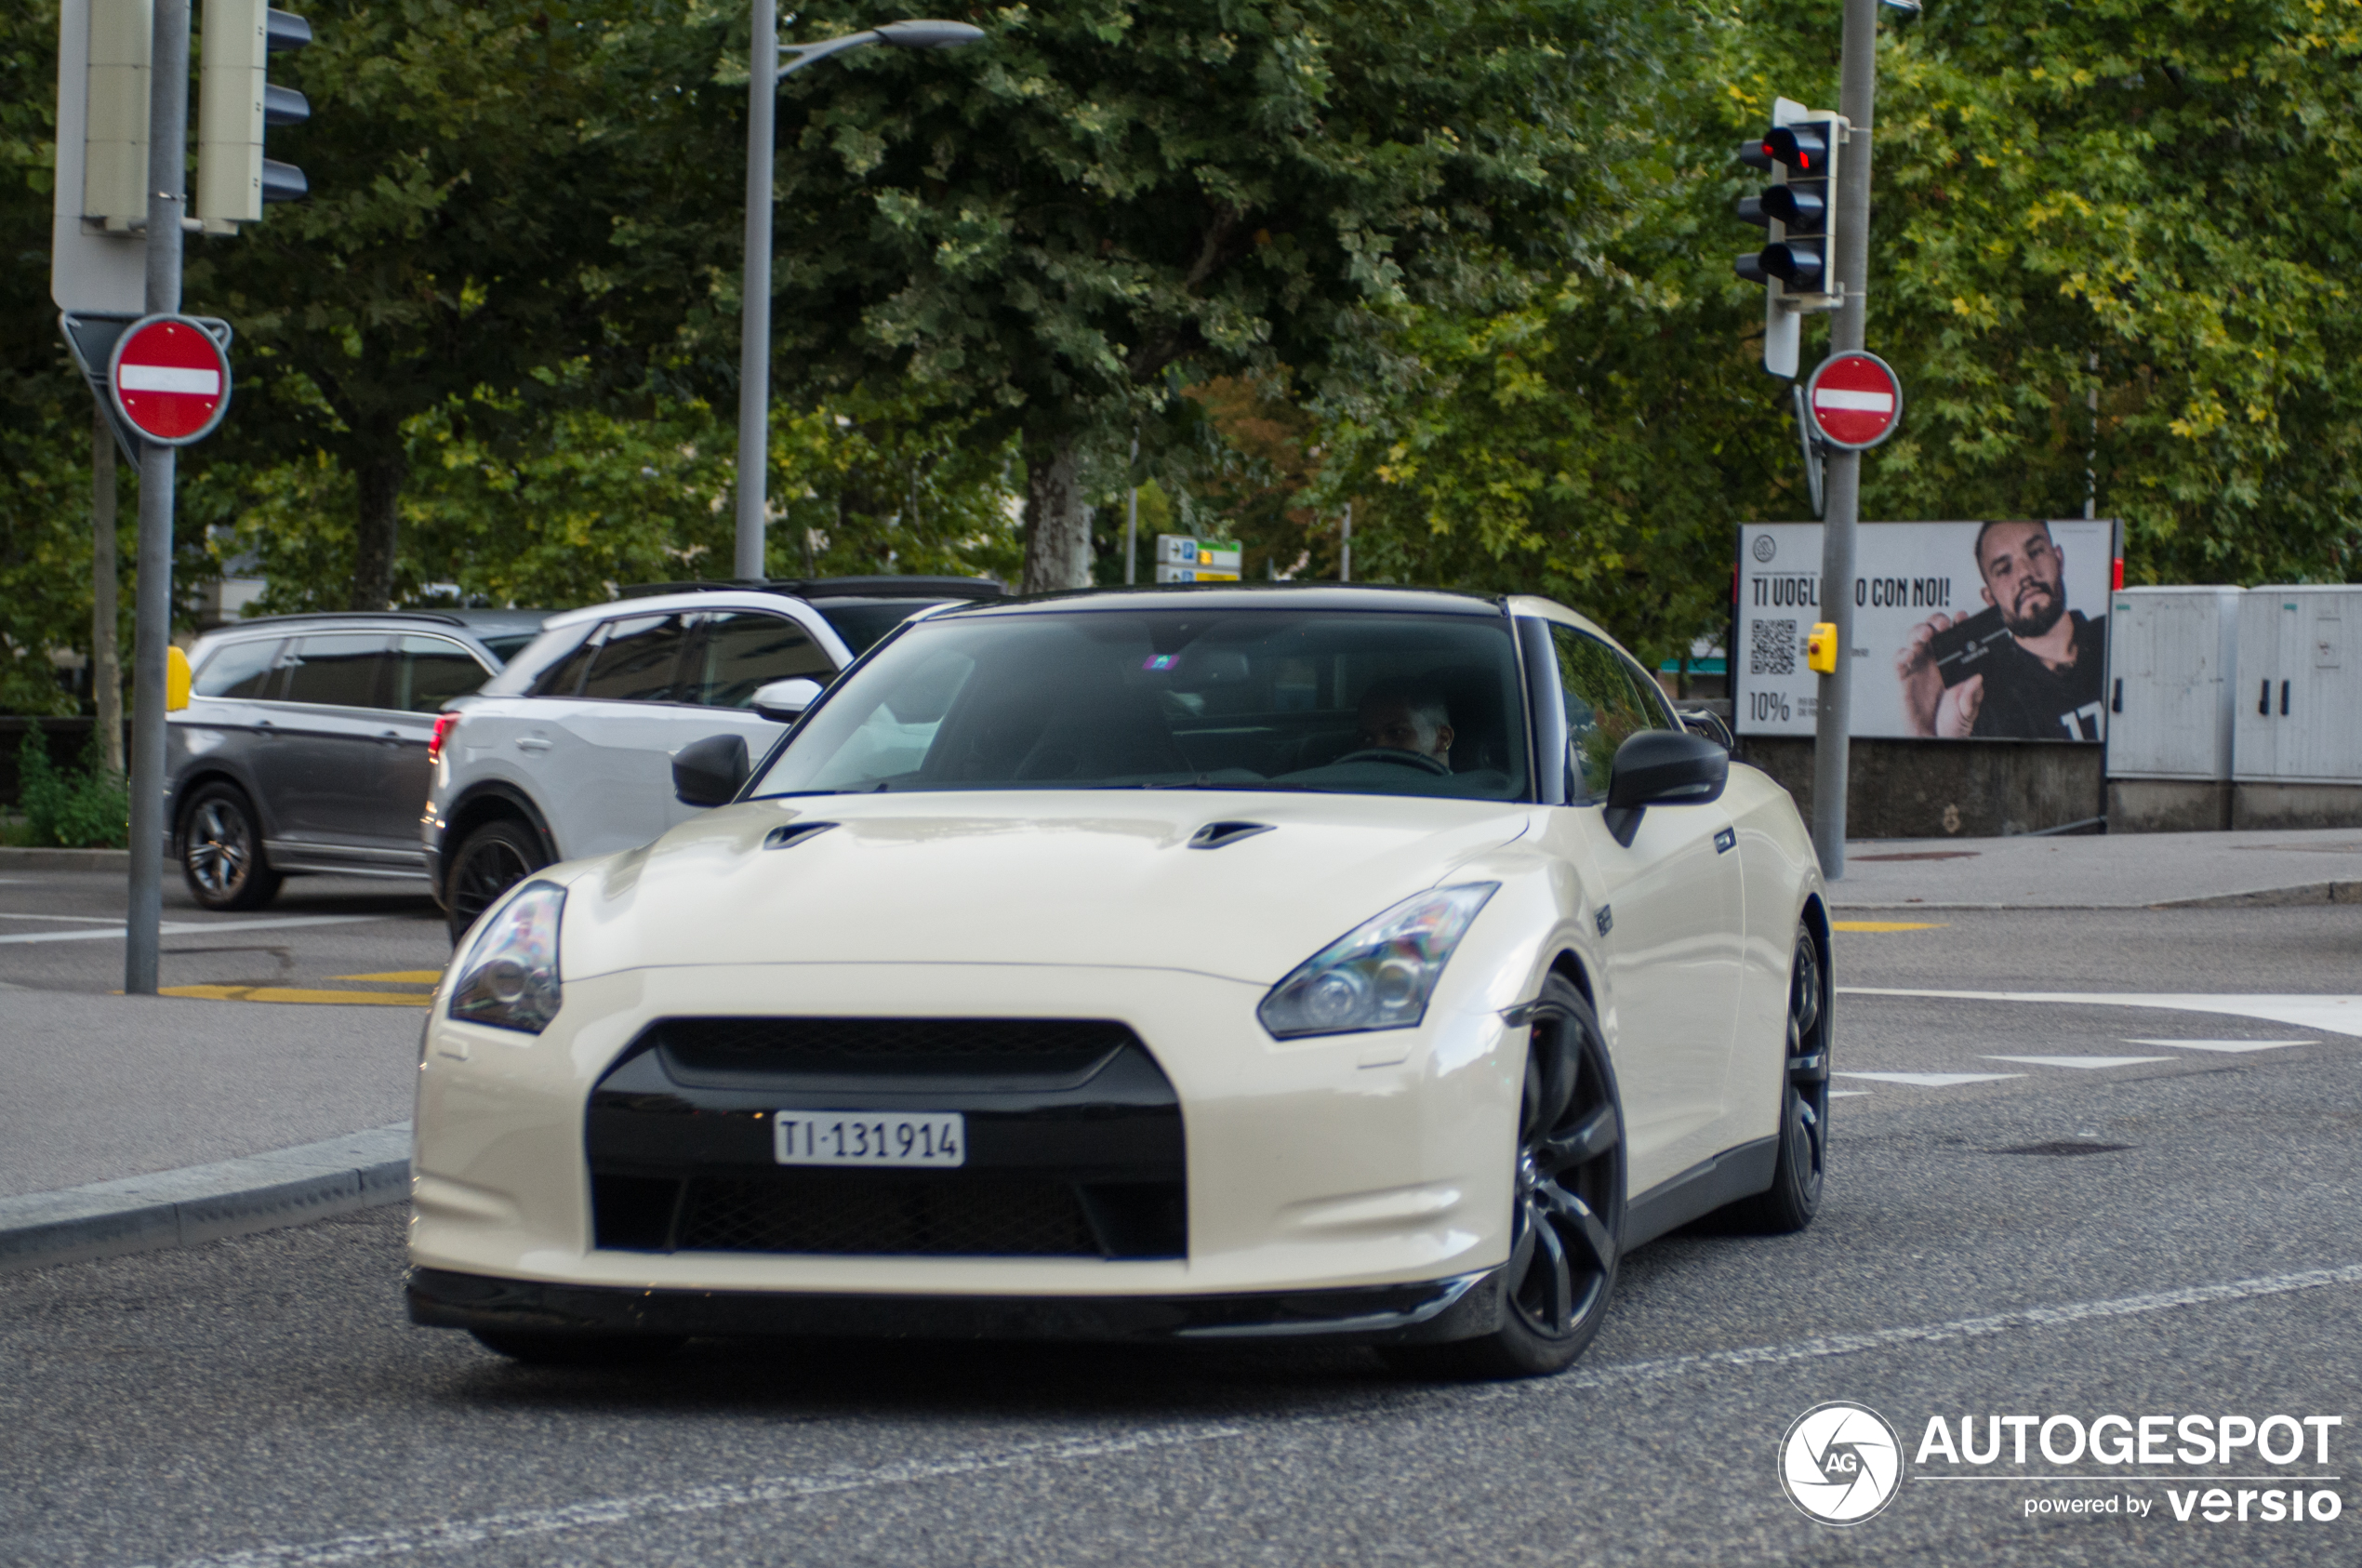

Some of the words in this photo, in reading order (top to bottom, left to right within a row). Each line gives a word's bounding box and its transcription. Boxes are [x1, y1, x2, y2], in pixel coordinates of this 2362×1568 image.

[1752, 578, 1768, 606] TI
[1872, 578, 1907, 607] CON
[1913, 578, 1950, 607] NOI!
[1750, 692, 1790, 722] 10%
